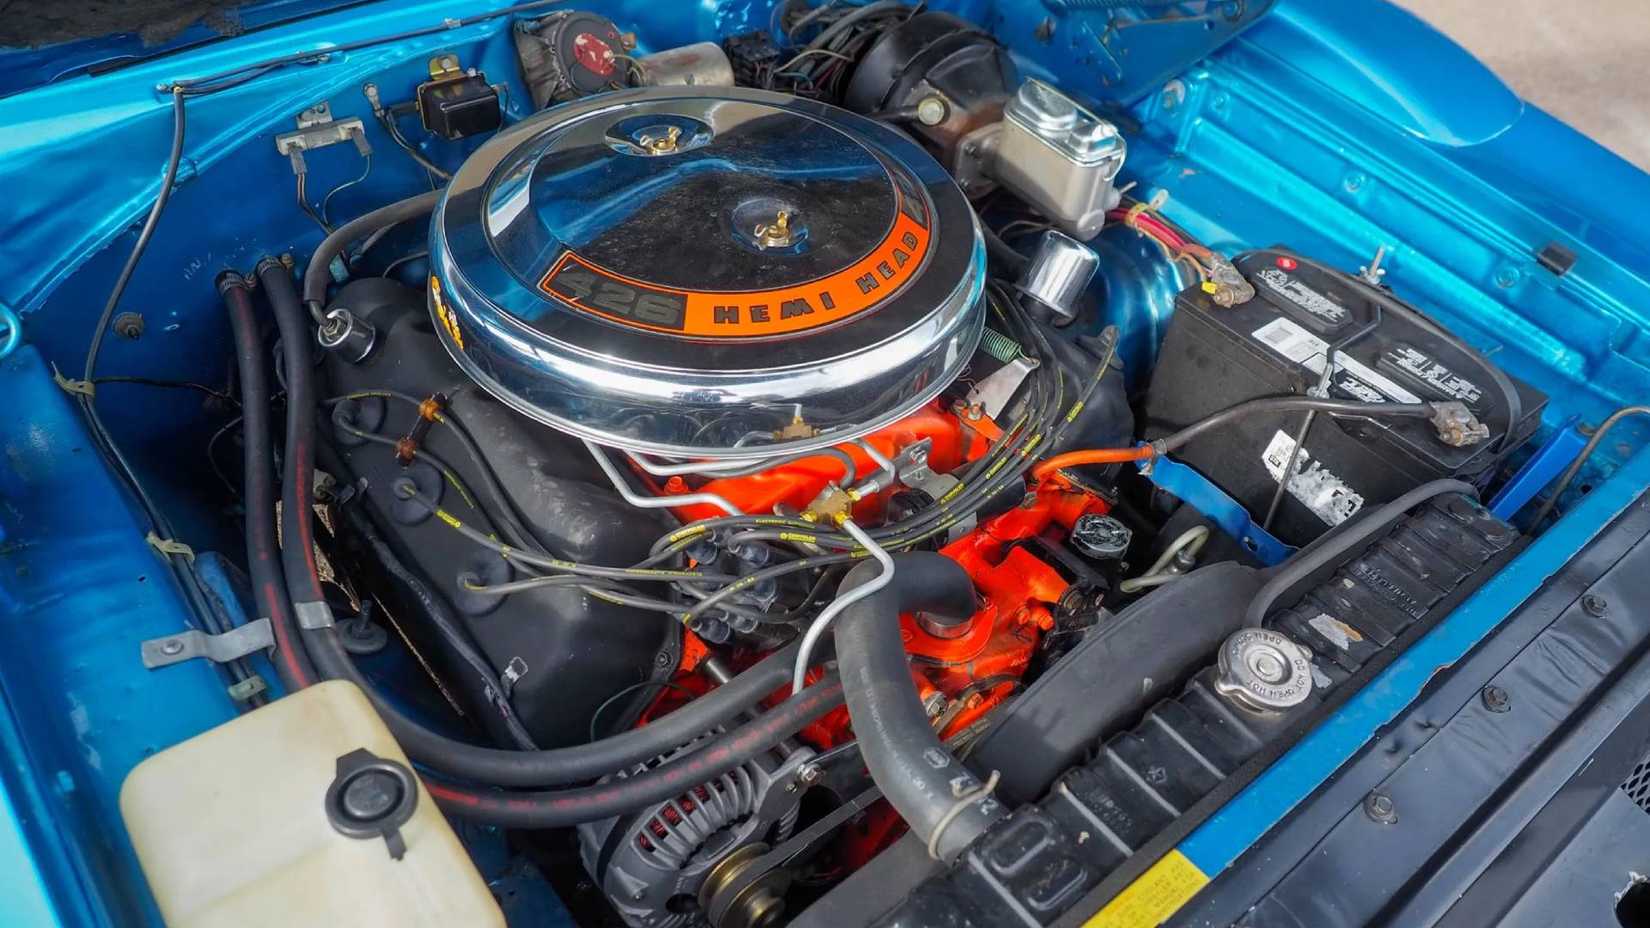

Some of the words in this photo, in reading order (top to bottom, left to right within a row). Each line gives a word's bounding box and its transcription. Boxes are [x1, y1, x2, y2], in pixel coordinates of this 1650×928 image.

[557, 268, 683, 325] 426
[713, 291, 836, 324] HEMI
[855, 231, 919, 295] HEAD
